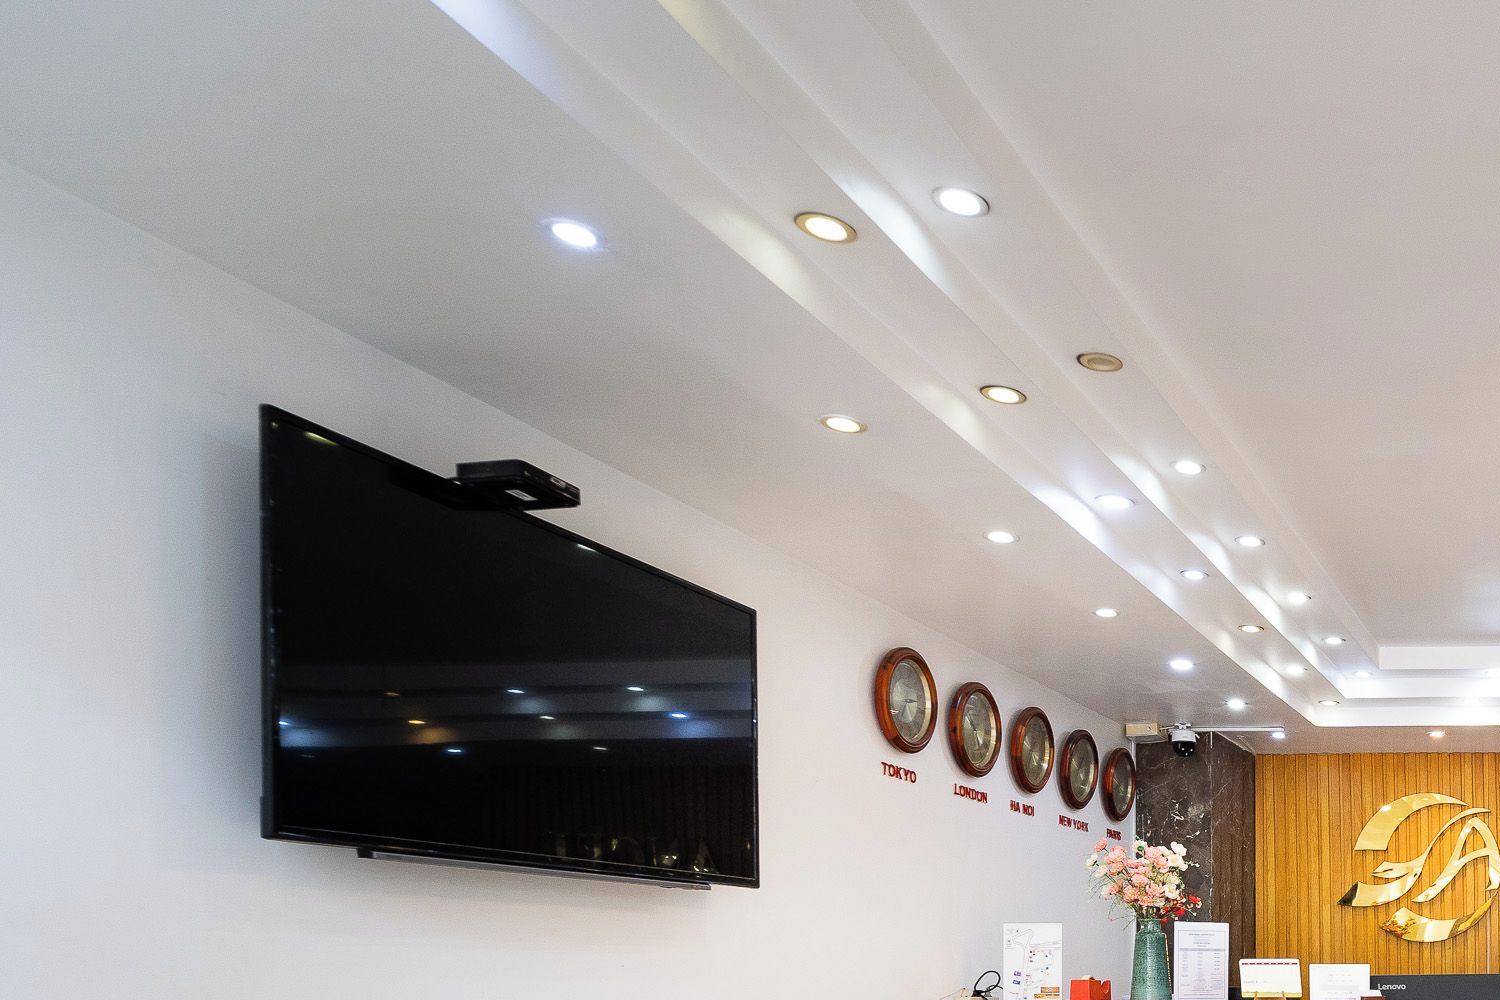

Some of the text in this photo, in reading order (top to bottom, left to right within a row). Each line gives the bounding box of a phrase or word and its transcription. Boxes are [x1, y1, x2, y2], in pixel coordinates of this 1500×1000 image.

[881, 761, 917, 783] TOKYO
[953, 783, 988, 803] LONDON
[1009, 800, 1035, 817] HA NOI
[1058, 815, 1089, 832] NEW YORK
[1106, 828, 1121, 841] PARIS
[1377, 983, 1407, 991] Lenovo
